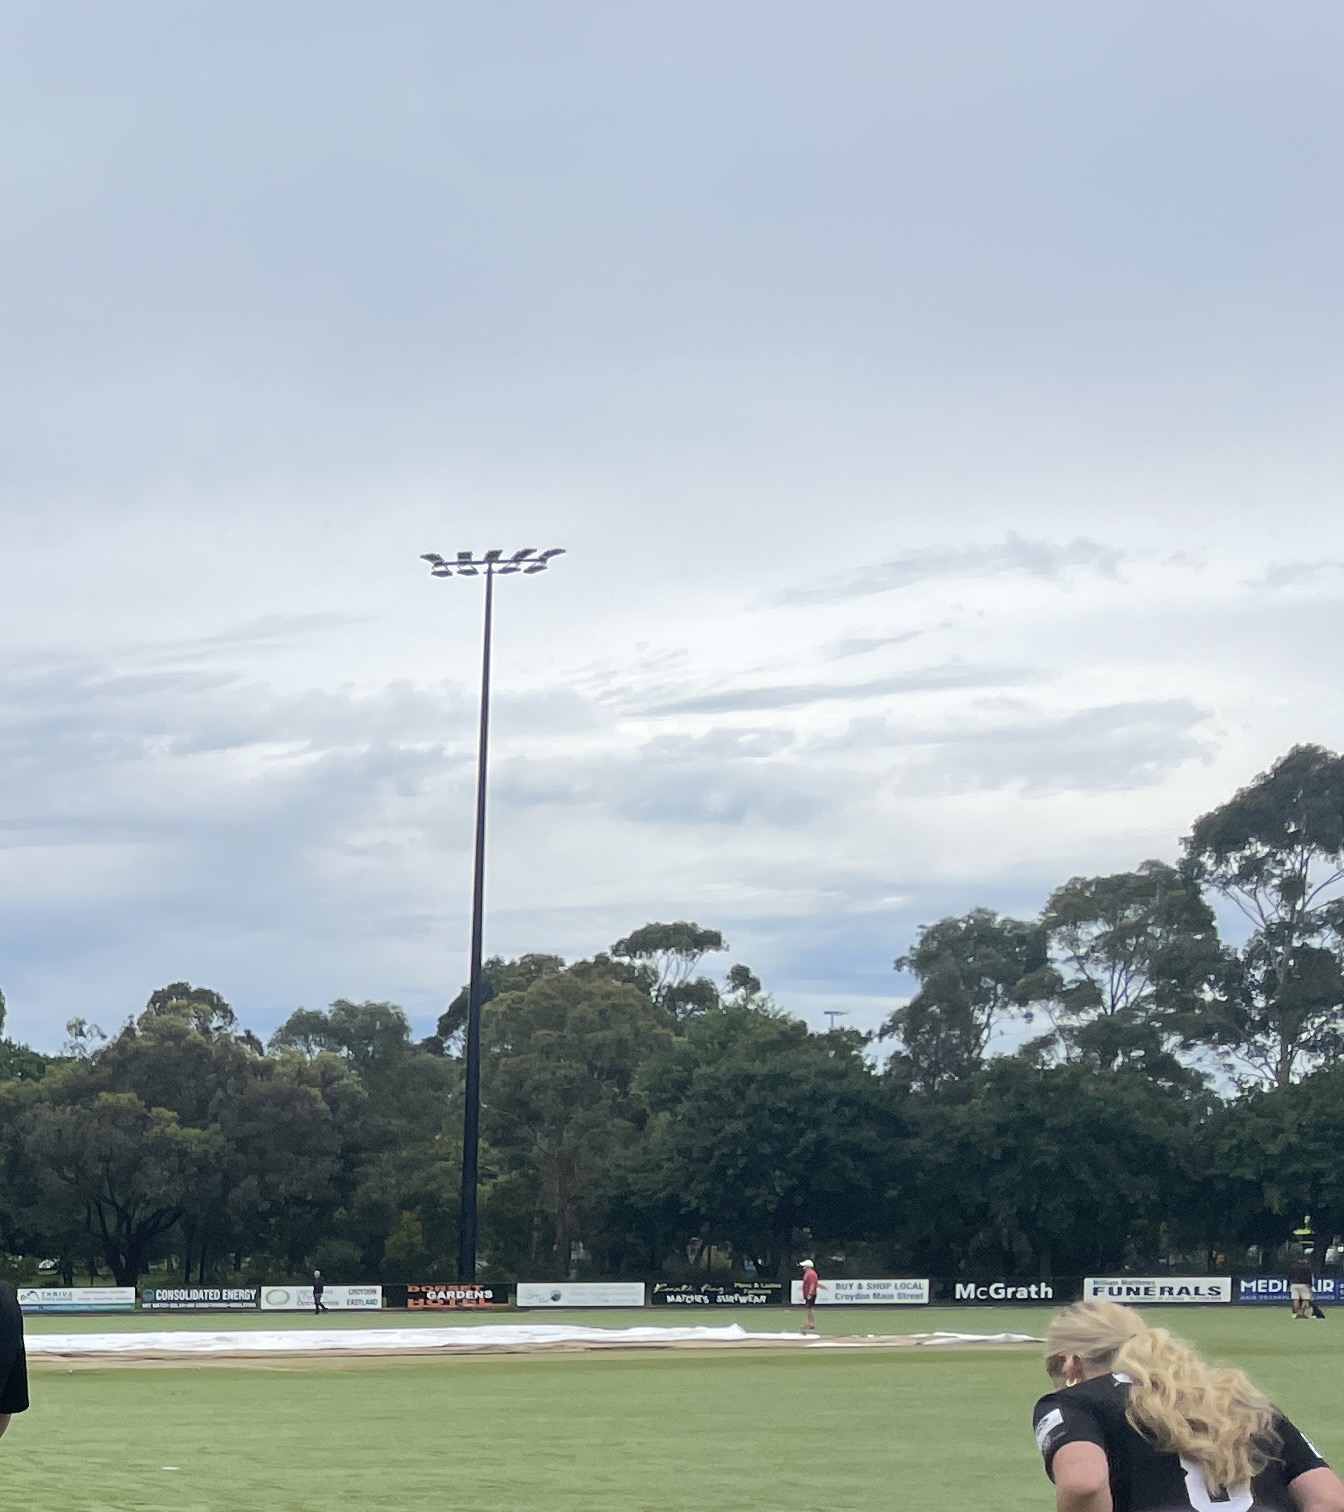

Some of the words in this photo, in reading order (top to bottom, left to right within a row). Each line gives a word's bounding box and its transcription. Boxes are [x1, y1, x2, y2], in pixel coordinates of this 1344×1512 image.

[835, 1282, 854, 1290] BUY
[866, 1282, 892, 1290] SHOP
[894, 1282, 924, 1290] LOCAL
[955, 1282, 1053, 1299] McGrath
[1092, 1286, 1222, 1297] FUNERALS
[155, 1288, 221, 1301] CONSOLIDATED
[222, 1288, 257, 1301] ENERGY
[426, 1289, 494, 1300] GARDENS
[872, 1292, 894, 1300] Main
[897, 1292, 924, 1300] Street
